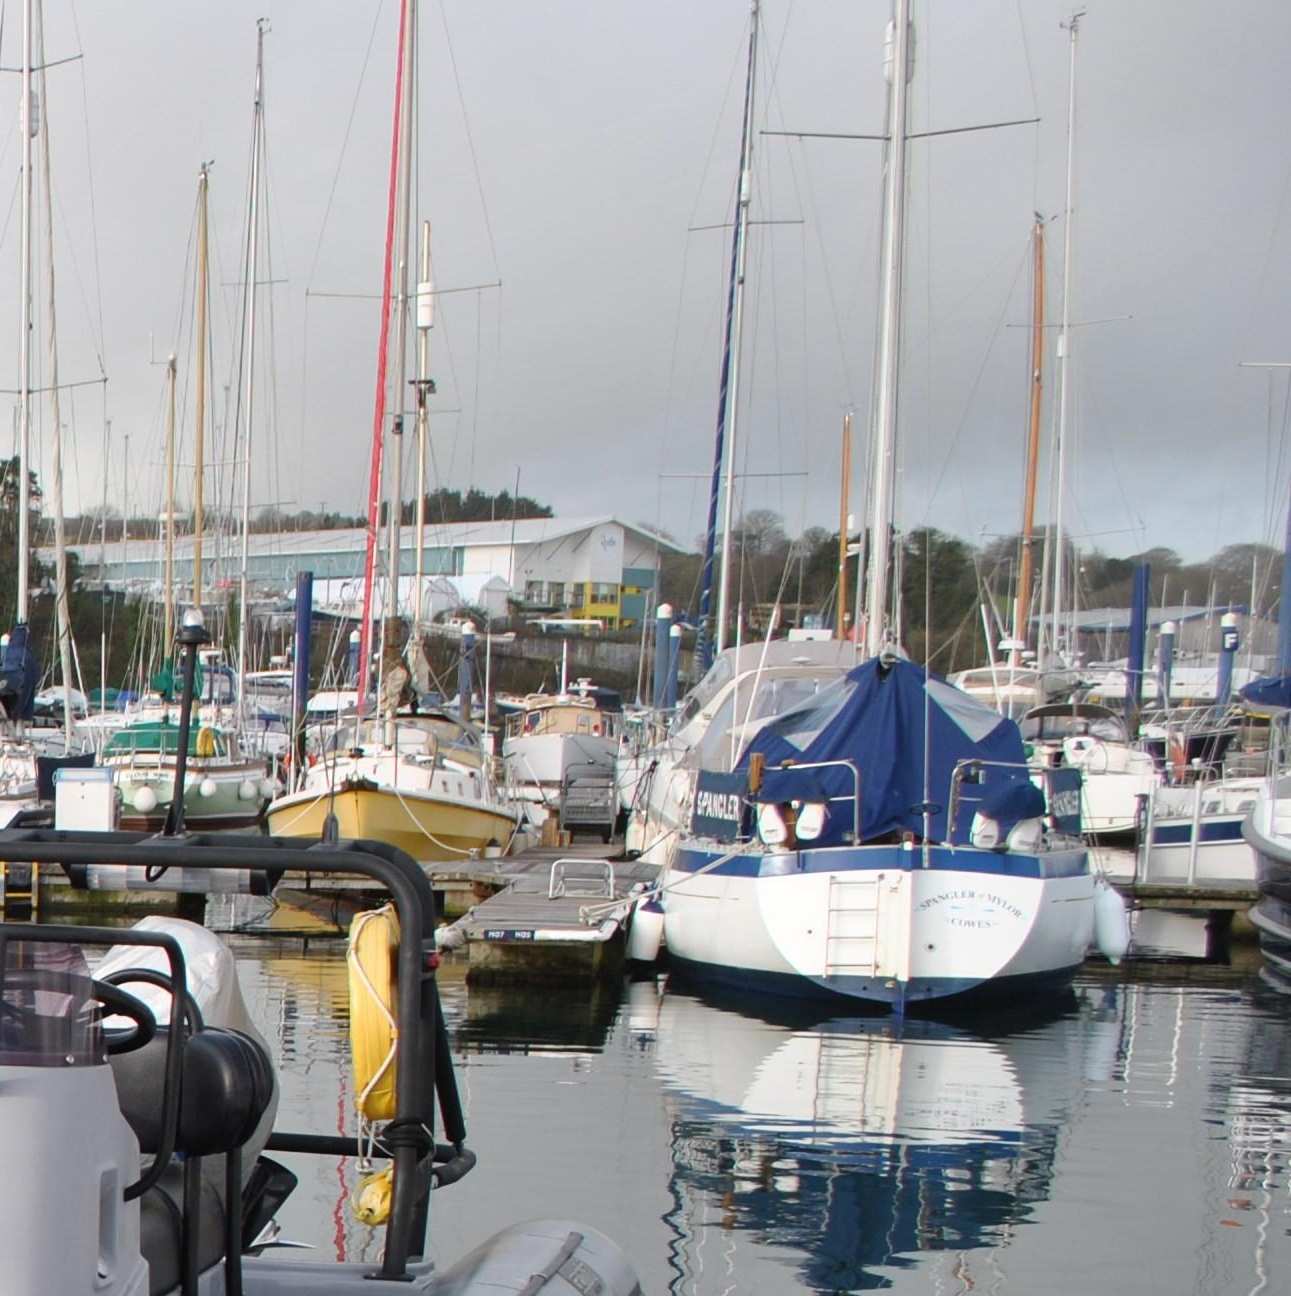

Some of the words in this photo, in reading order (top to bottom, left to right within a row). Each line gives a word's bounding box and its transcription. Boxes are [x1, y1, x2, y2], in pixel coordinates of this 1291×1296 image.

[1225, 633, 1237, 649] F
[697, 790, 739, 820] SPANGLER
[919, 890, 975, 911] SPANGLER
[951, 918, 992, 928] COWES
